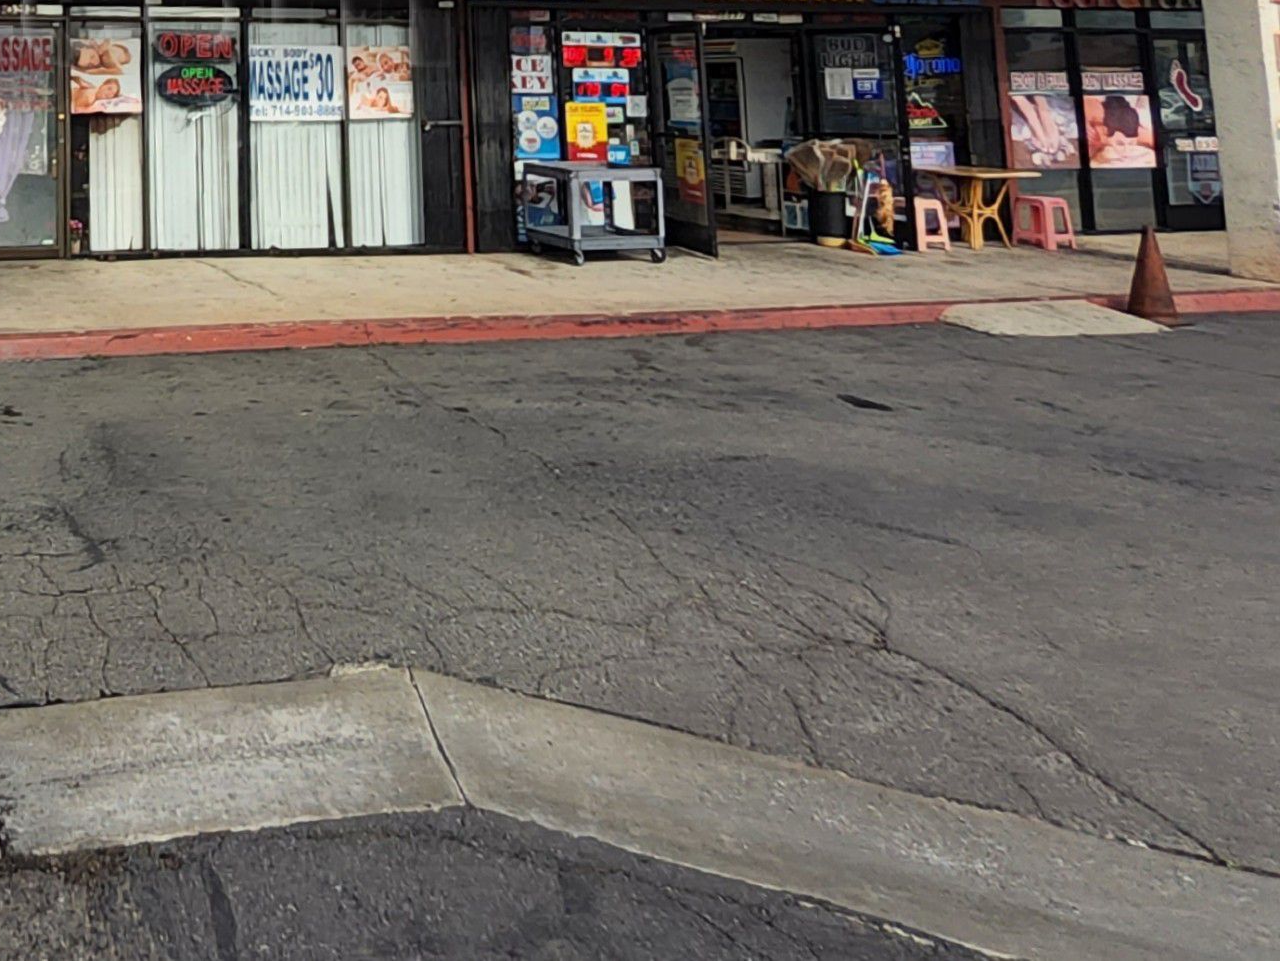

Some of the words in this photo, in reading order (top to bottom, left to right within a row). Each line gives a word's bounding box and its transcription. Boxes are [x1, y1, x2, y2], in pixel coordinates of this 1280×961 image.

[160, 33, 234, 60] OPEN
[249, 48, 276, 57] UCKY
[181, 67, 214, 79] OPEN
[166, 78, 225, 95] MASSAGE
